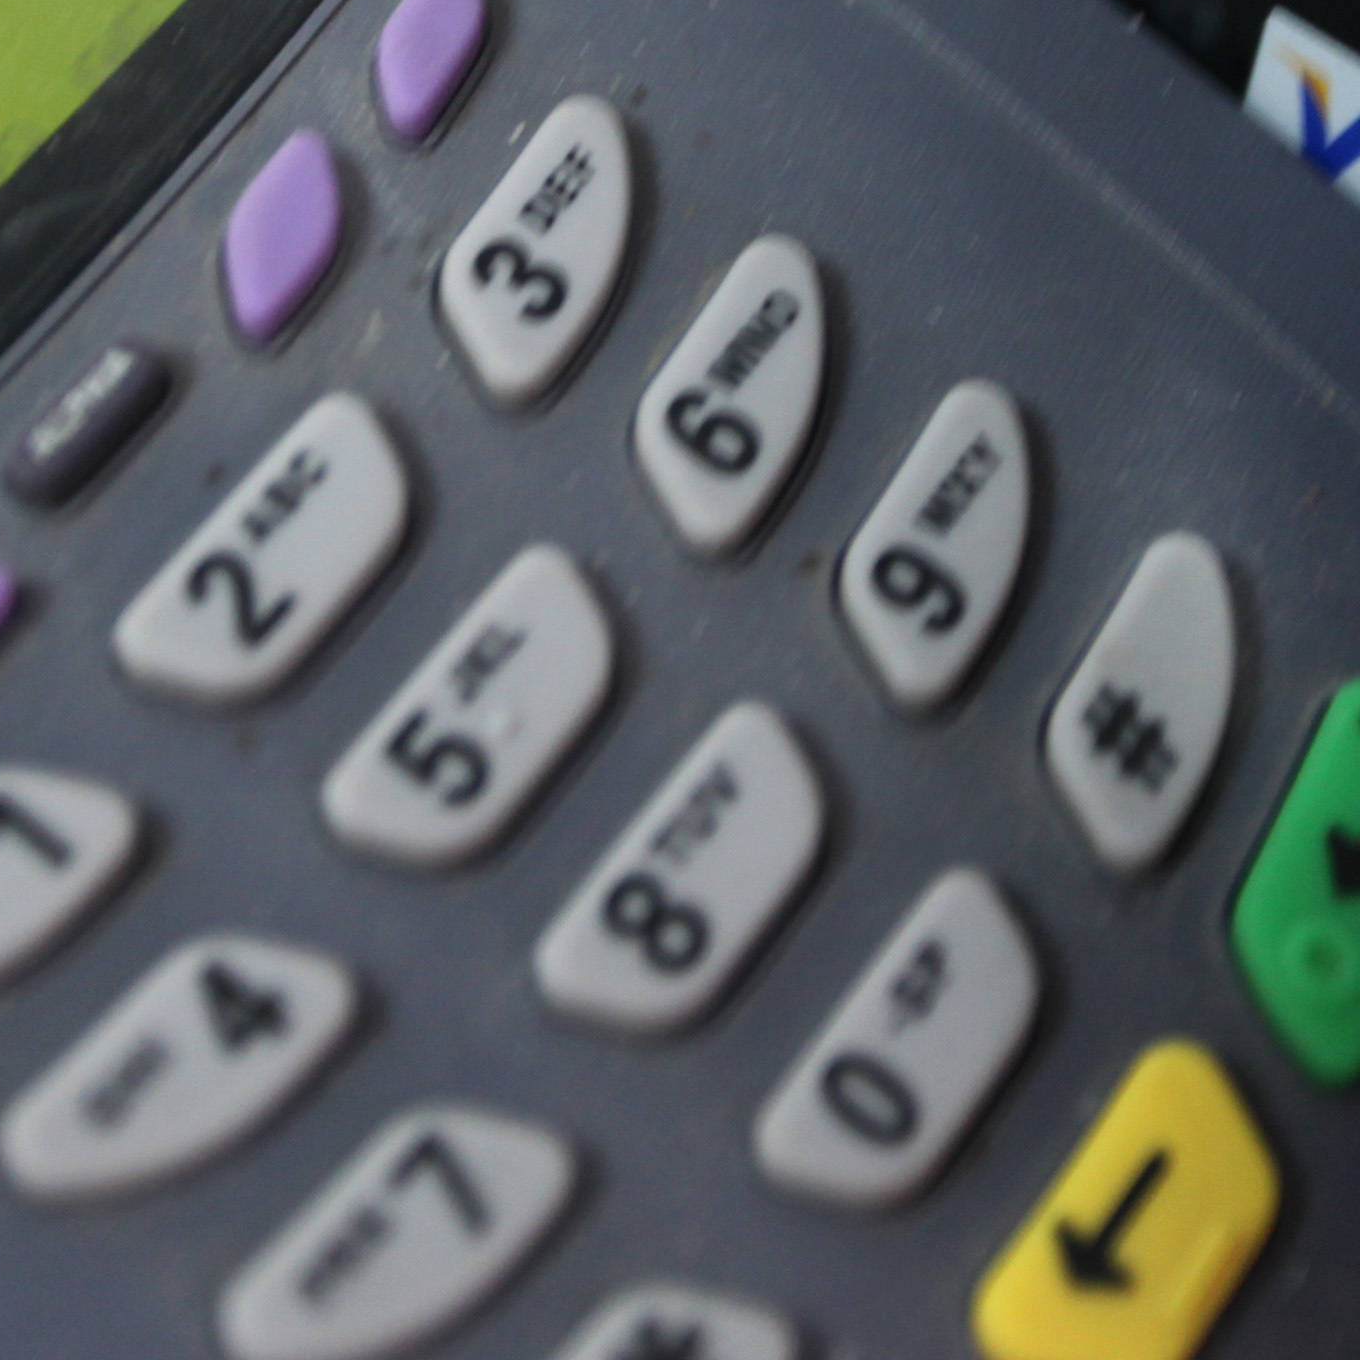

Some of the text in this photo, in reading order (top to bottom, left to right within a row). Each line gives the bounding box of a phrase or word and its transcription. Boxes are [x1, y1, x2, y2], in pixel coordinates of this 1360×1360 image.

[471, 143, 596, 322] 3 DEF
[665, 386, 760, 478] 6
[186, 548, 296, 646] 2
[869, 545, 967, 637] 9
[385, 710, 489, 807] 5
[601, 871, 709, 973] 8
[197, 961, 289, 1054] 4
[819, 1053, 919, 1148] 0
[389, 1133, 488, 1236] 7
